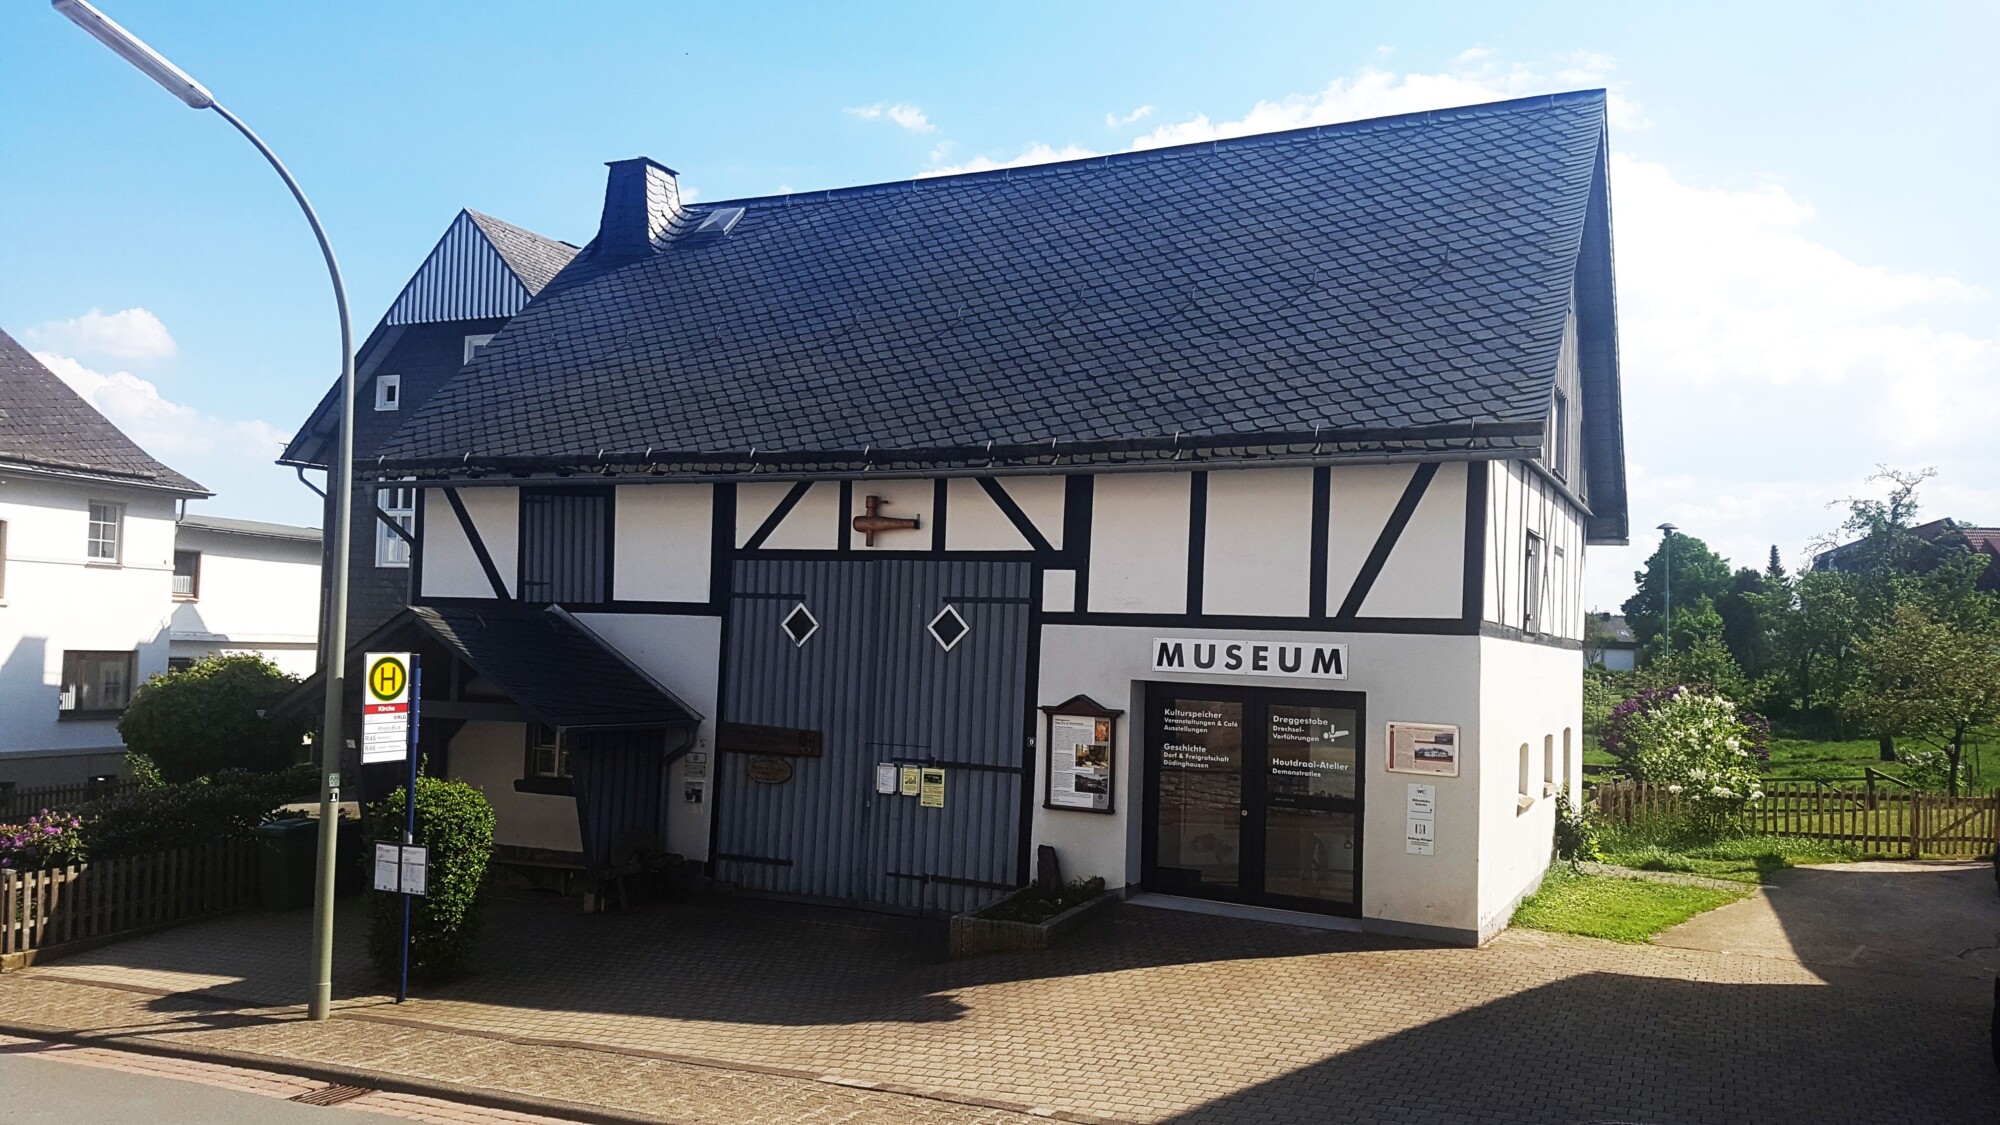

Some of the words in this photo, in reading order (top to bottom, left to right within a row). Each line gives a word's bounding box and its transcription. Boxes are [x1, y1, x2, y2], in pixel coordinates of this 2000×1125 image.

[1156, 642, 1343, 675] MUSEUM
[380, 666, 396, 692] H
[1164, 708, 1223, 719] Kulturspeicher
[1164, 717, 1216, 727] Veranstaltungen
[1163, 725, 1208, 734] Ausstellungen
[1272, 725, 1305, 733] Drechsel-
[1272, 733, 1320, 742] Vorführungen
[1163, 743, 1207, 753] Geschichte
[1185, 753, 1230, 762] Freigrafschaft
[1163, 760, 1209, 769] Düdinghausen
[1272, 757, 1349, 771] Houtdraai-Atelier
[1272, 768, 1321, 778] Demonstraties
